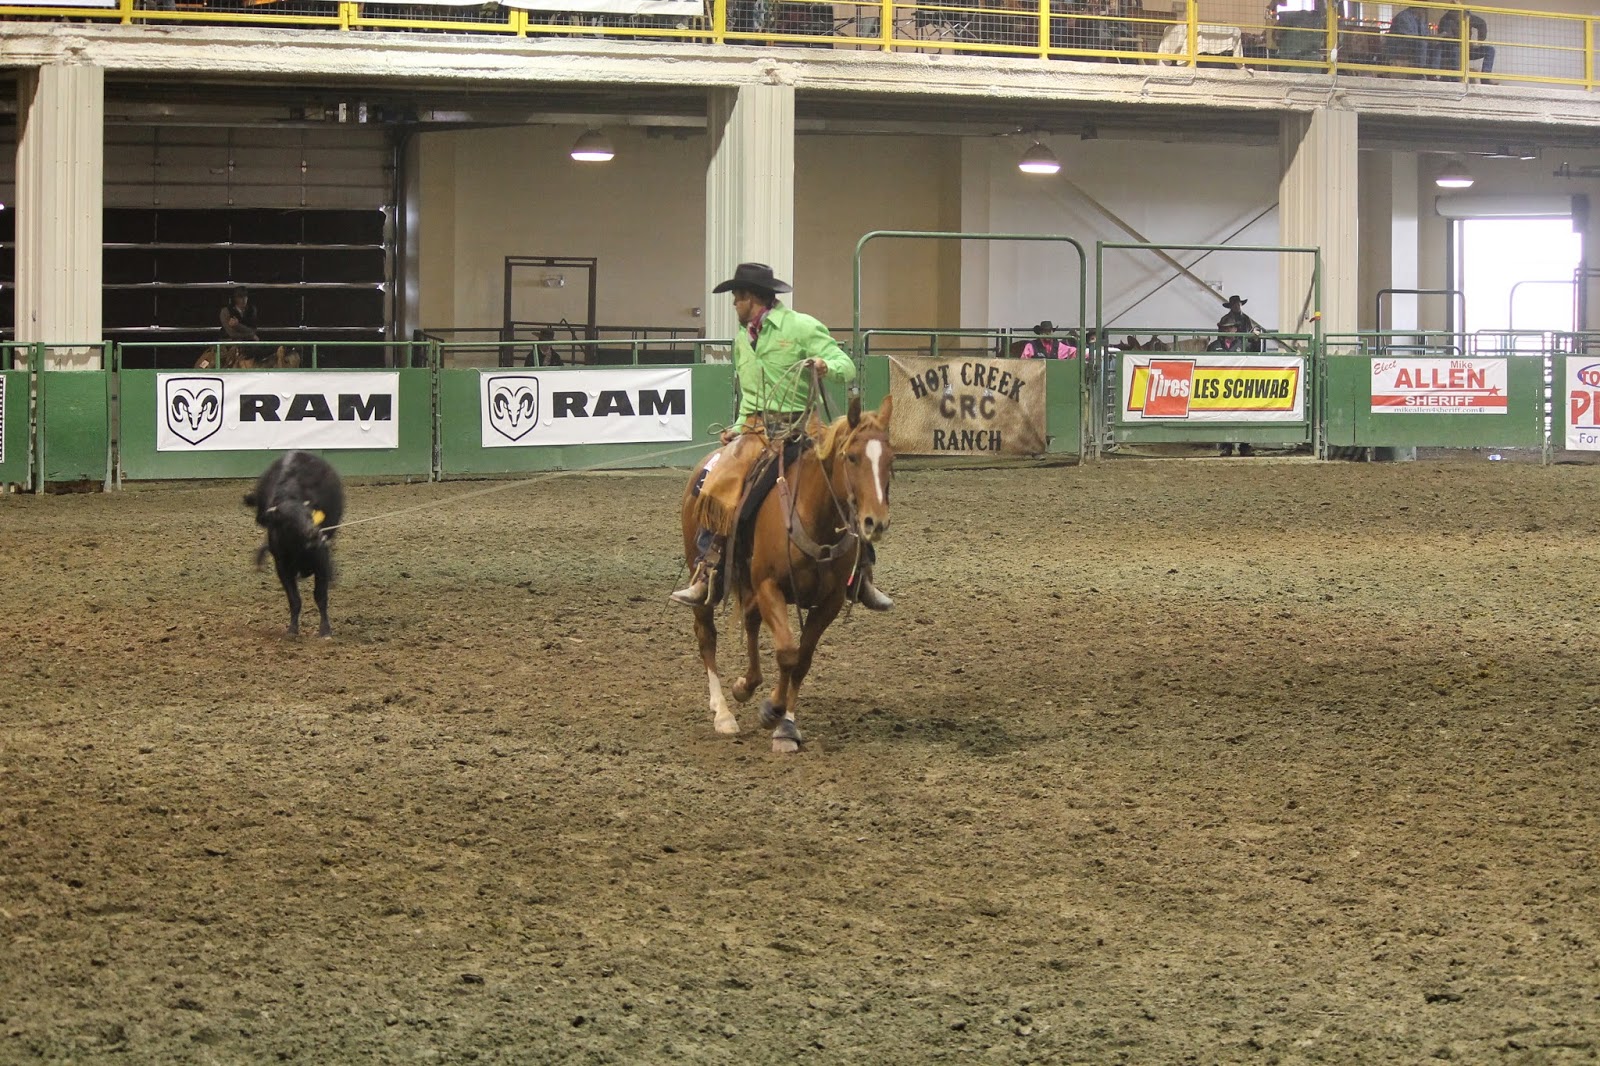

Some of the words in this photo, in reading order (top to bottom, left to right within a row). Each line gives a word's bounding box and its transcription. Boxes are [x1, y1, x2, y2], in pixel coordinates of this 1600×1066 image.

[1373, 360, 1397, 375] Elect
[1450, 360, 1473, 369] Mike
[909, 364, 951, 399] HOT
[960, 362, 1026, 402] CREEK
[1150, 369, 1190, 401] Tires
[1193, 378, 1219, 399] LES
[1222, 378, 1289, 399] SCHWAB
[1394, 368, 1486, 389] ALLEN
[239, 394, 392, 422] RAM
[552, 389, 686, 418] RAM
[939, 394, 996, 420] CRC
[1405, 396, 1475, 406] SHERIFF
[933, 429, 1002, 451] RANCH
[1579, 432, 1598, 443] For
